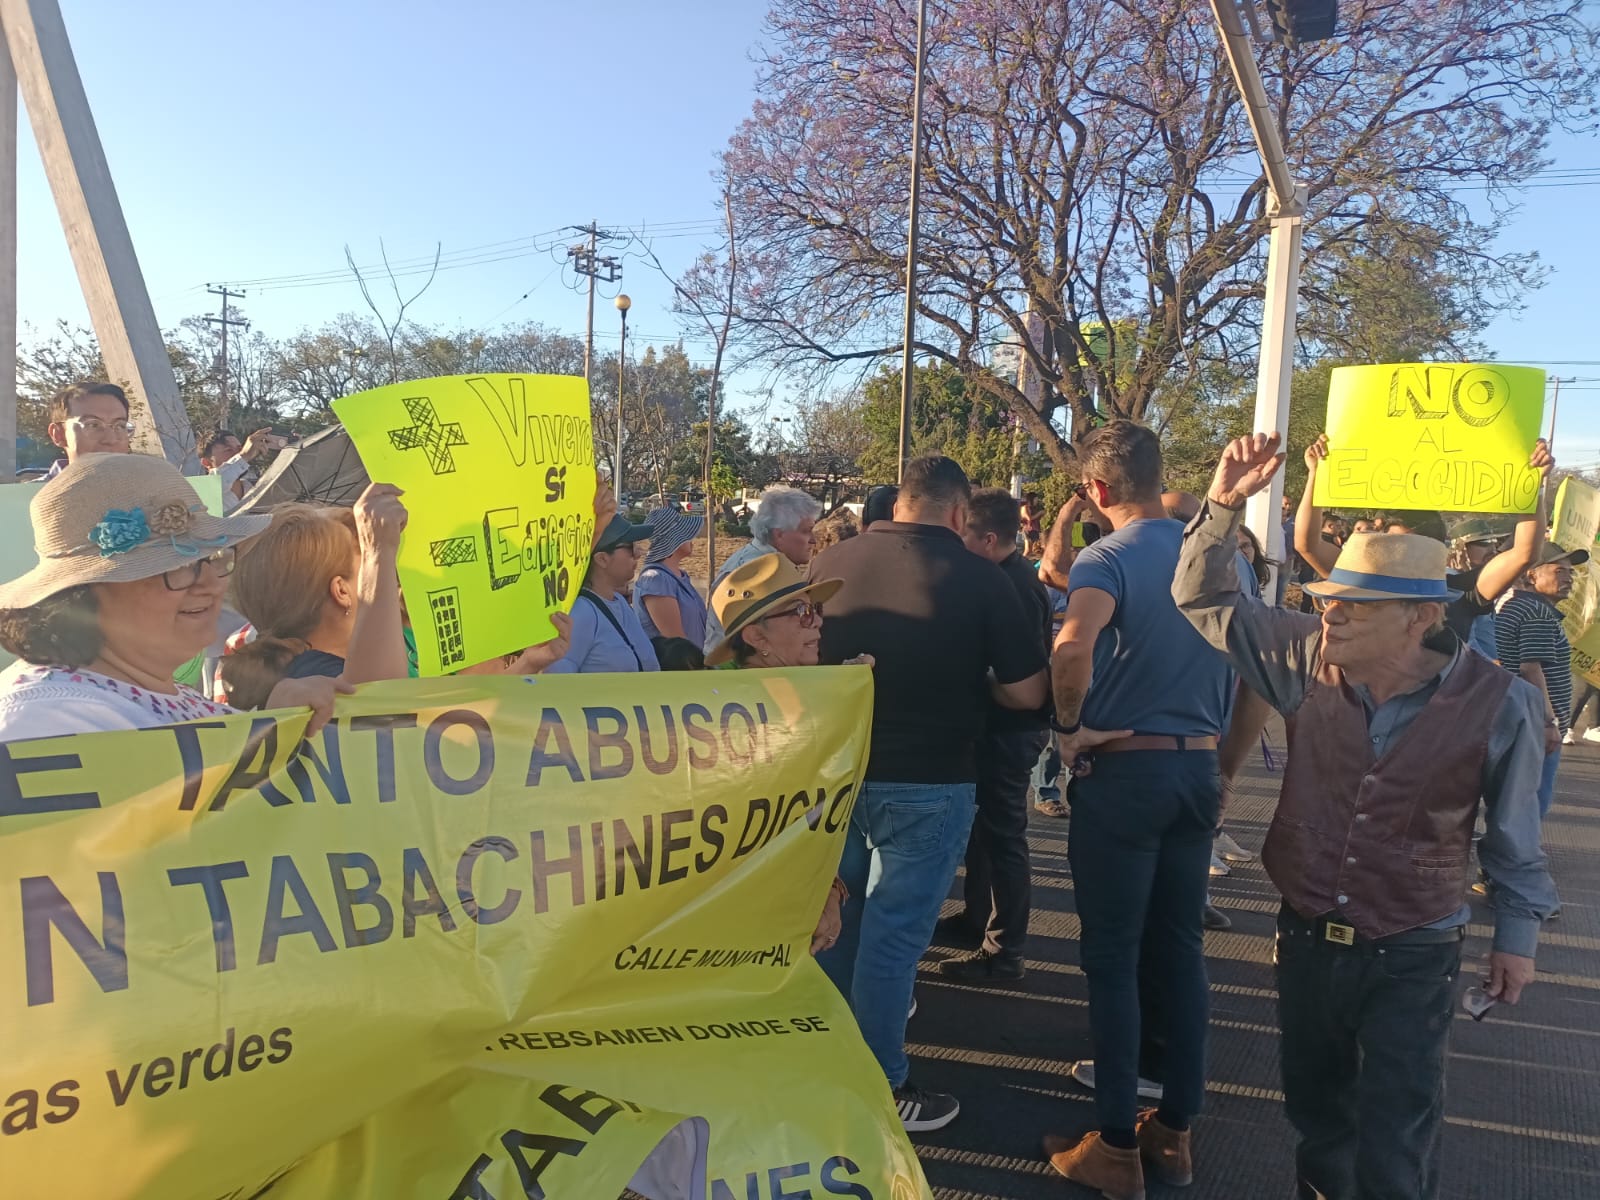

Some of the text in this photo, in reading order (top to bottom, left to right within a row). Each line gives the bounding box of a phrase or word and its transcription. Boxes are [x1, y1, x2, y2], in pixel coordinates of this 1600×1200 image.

[1387, 367, 1510, 427] NO
[1414, 427, 1463, 453] AL
[543, 567, 569, 608] NO
[138, 709, 495, 812] TANTO
[167, 803, 728, 973] TABACHINES
[615, 945, 698, 970] CALLE
[498, 1016, 830, 1051] REBSAMEN DONDE SE
[1, 1027, 292, 1136] as verdes
[447, 1084, 642, 1200] TAB
